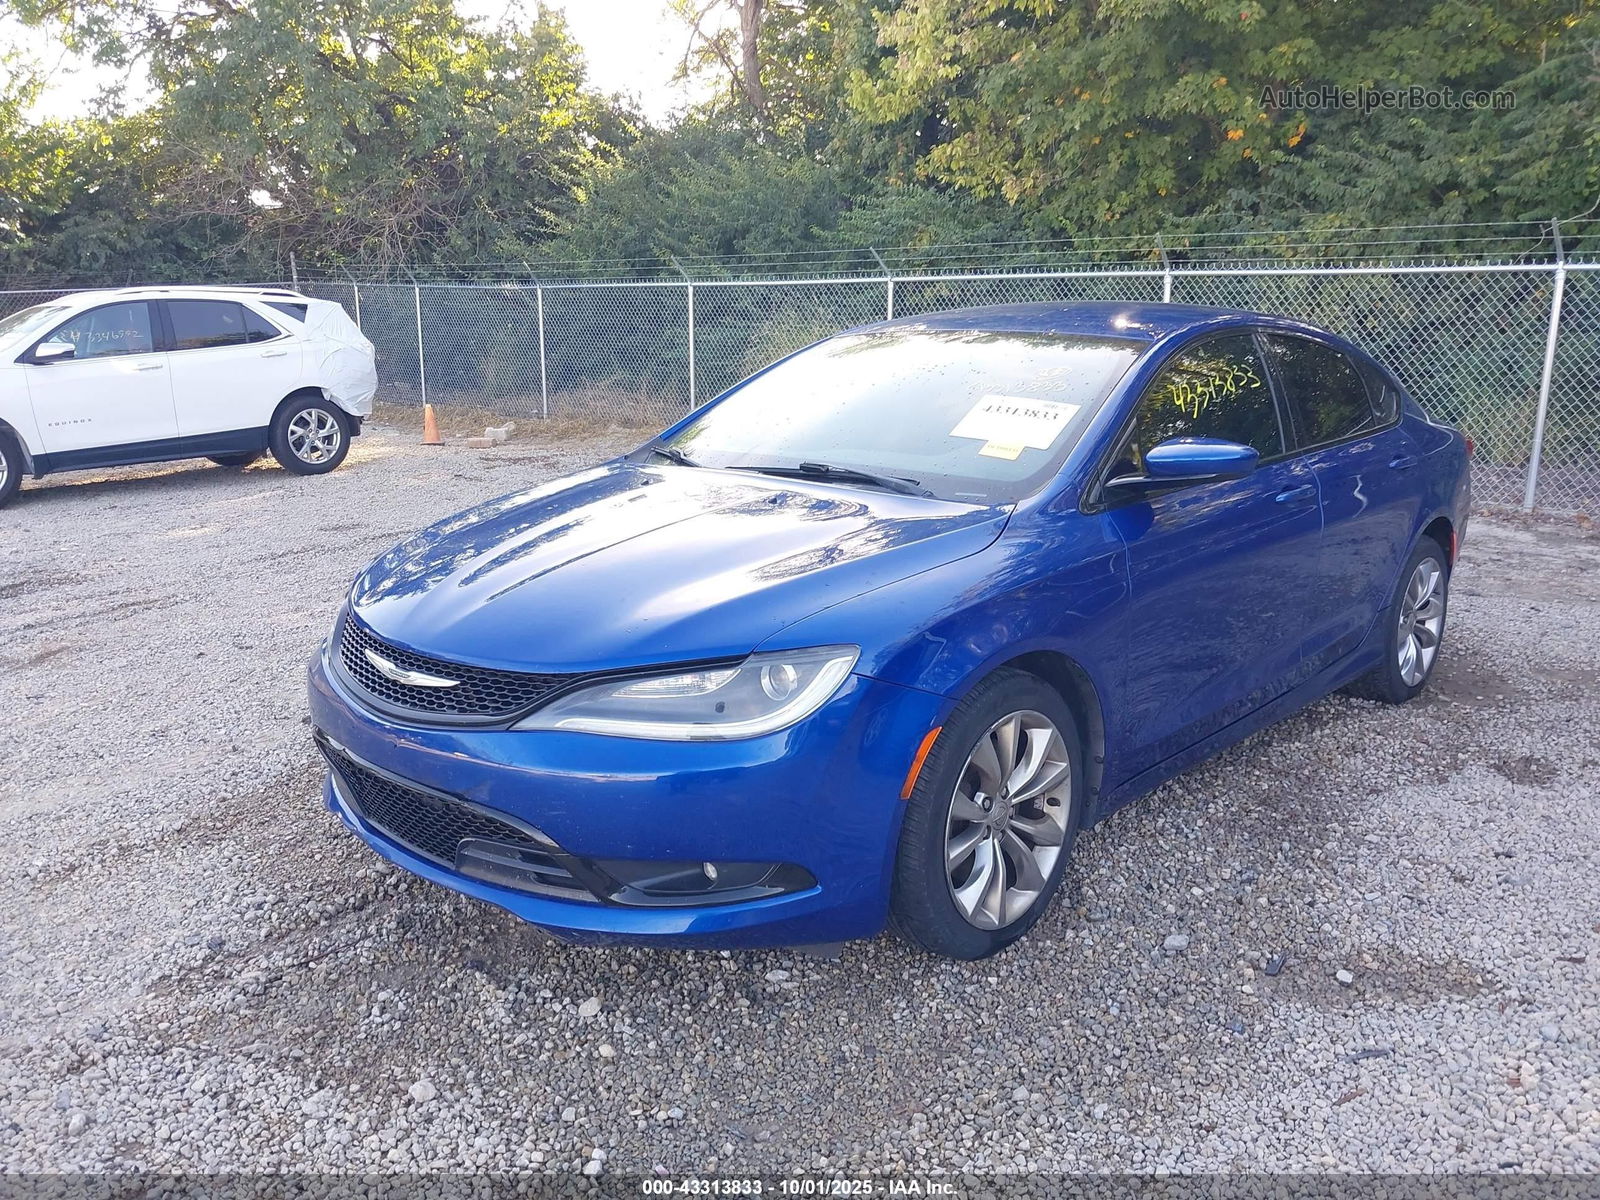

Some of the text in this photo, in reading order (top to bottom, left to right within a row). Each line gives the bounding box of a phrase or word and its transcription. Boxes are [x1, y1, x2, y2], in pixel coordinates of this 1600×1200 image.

[1167, 364, 1261, 419] 43313833
[982, 404, 1060, 421] 43313833
[48, 418, 92, 427] EQUINOX
